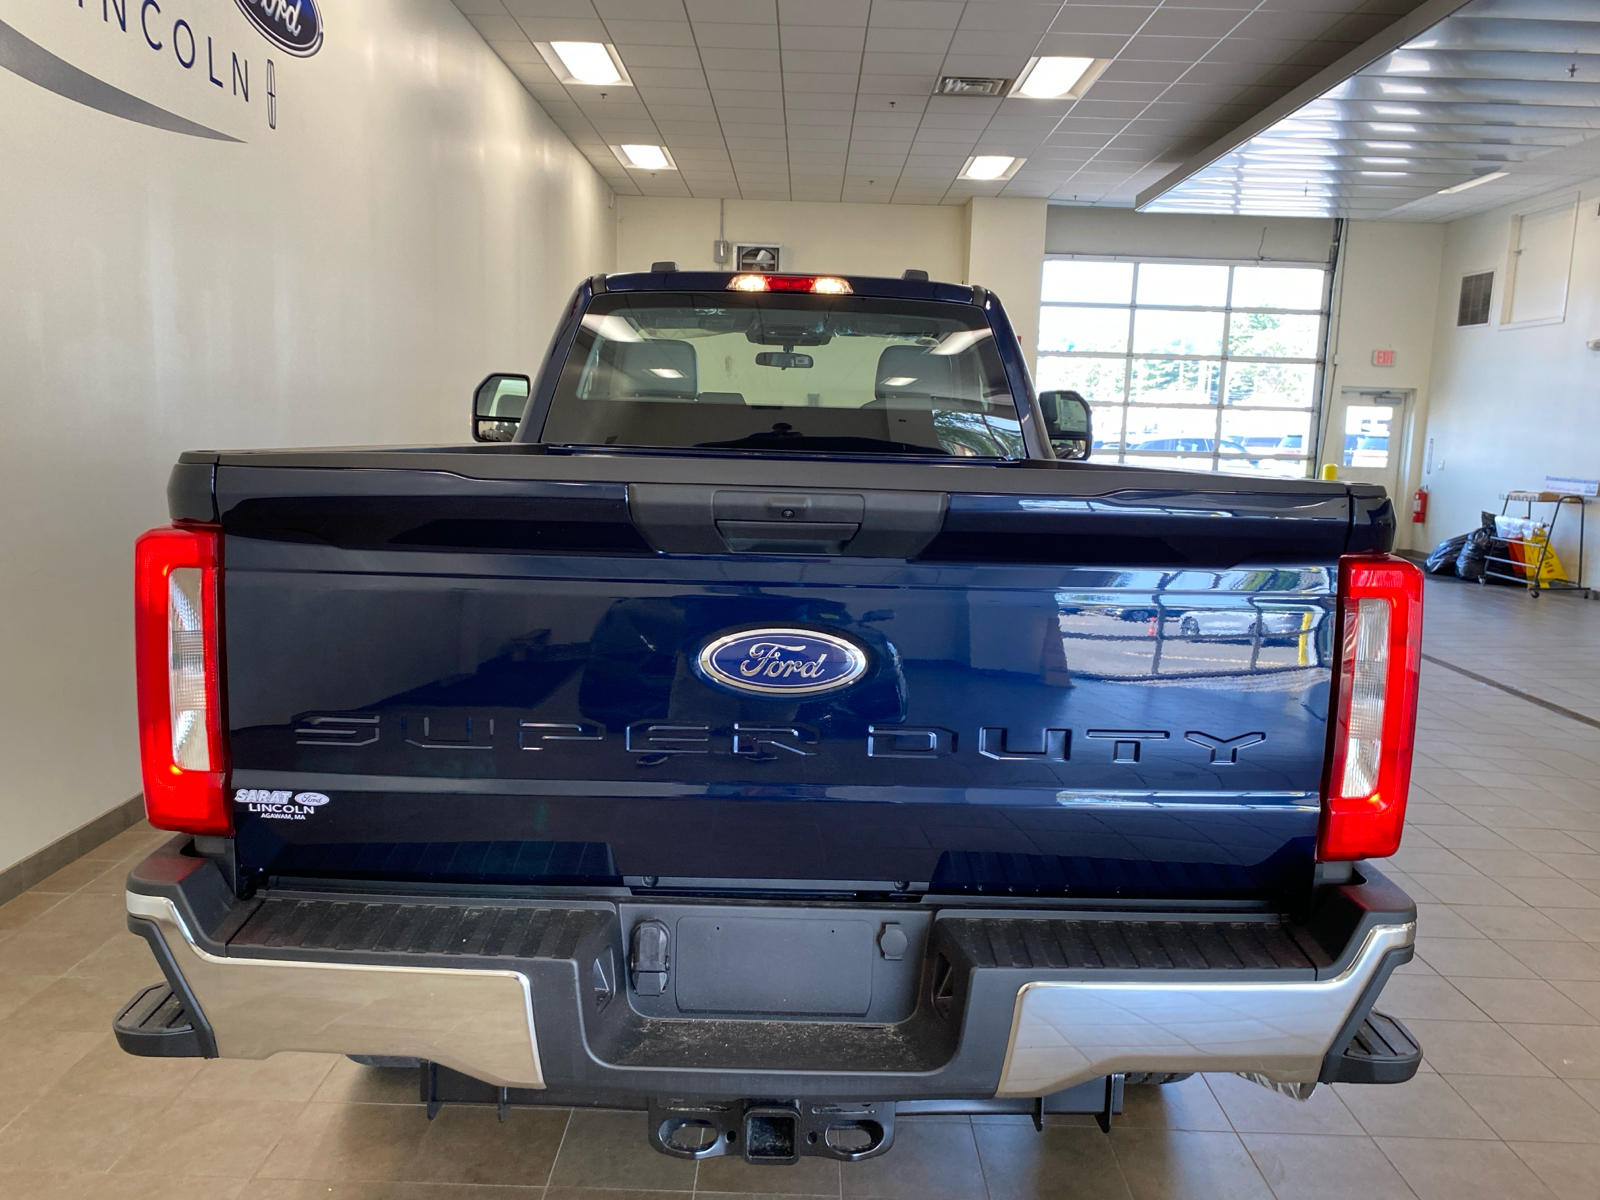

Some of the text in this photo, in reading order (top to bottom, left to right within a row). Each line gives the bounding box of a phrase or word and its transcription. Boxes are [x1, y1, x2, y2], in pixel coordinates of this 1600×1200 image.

[78, 0, 249, 103] NCOLN
[1376, 350, 1395, 365] EXIT
[740, 642, 828, 678] Ford
[293, 709, 1268, 766] SUPER DUTY
[235, 788, 293, 804] SARAT
[248, 803, 315, 814] LINCOLN
[260, 812, 294, 820] AGAWAM,
